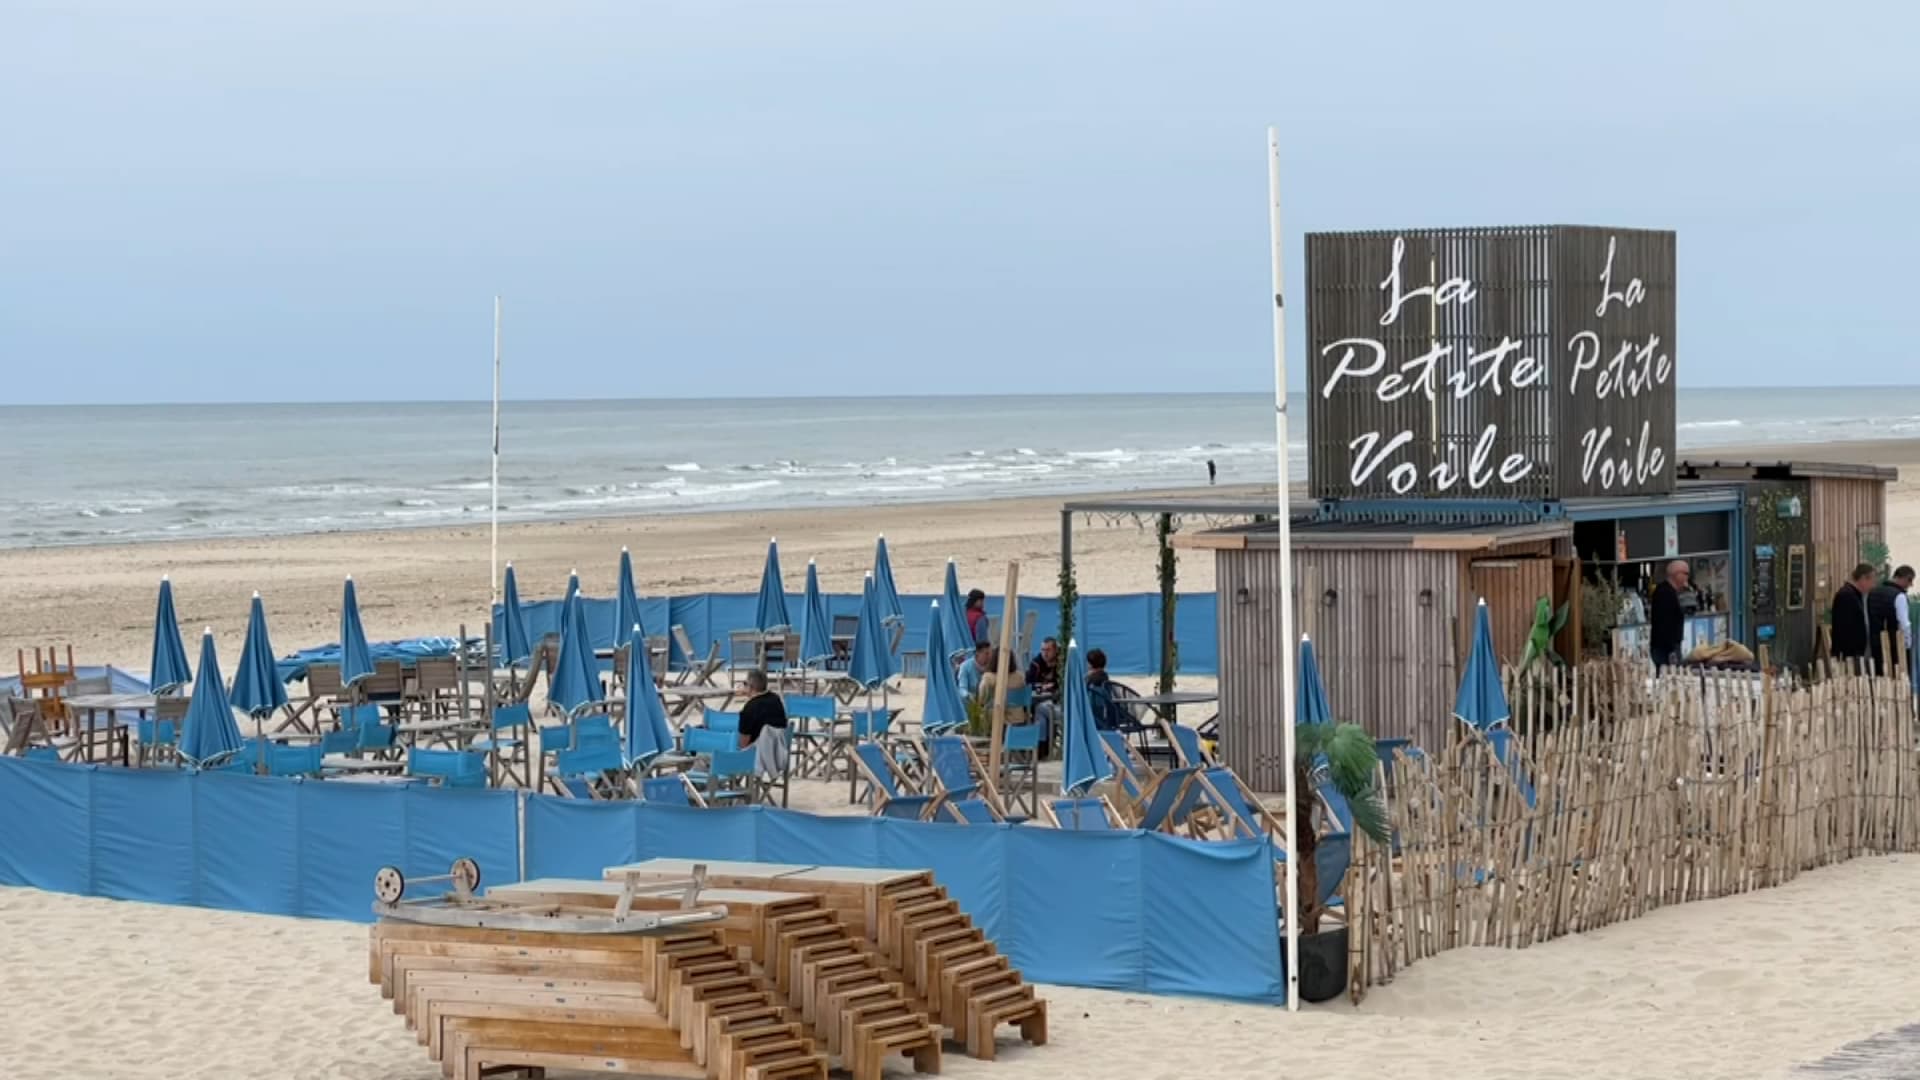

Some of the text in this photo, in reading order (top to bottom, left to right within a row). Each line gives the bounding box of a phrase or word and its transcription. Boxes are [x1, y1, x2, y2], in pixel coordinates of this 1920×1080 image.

[1379, 235, 1477, 325] La
[1595, 235, 1646, 318] La
[1322, 336, 1544, 402] Petite
[1567, 330, 1672, 399] Petite
[1349, 424, 1533, 494] Voile
[1580, 420, 1665, 489] Voile
